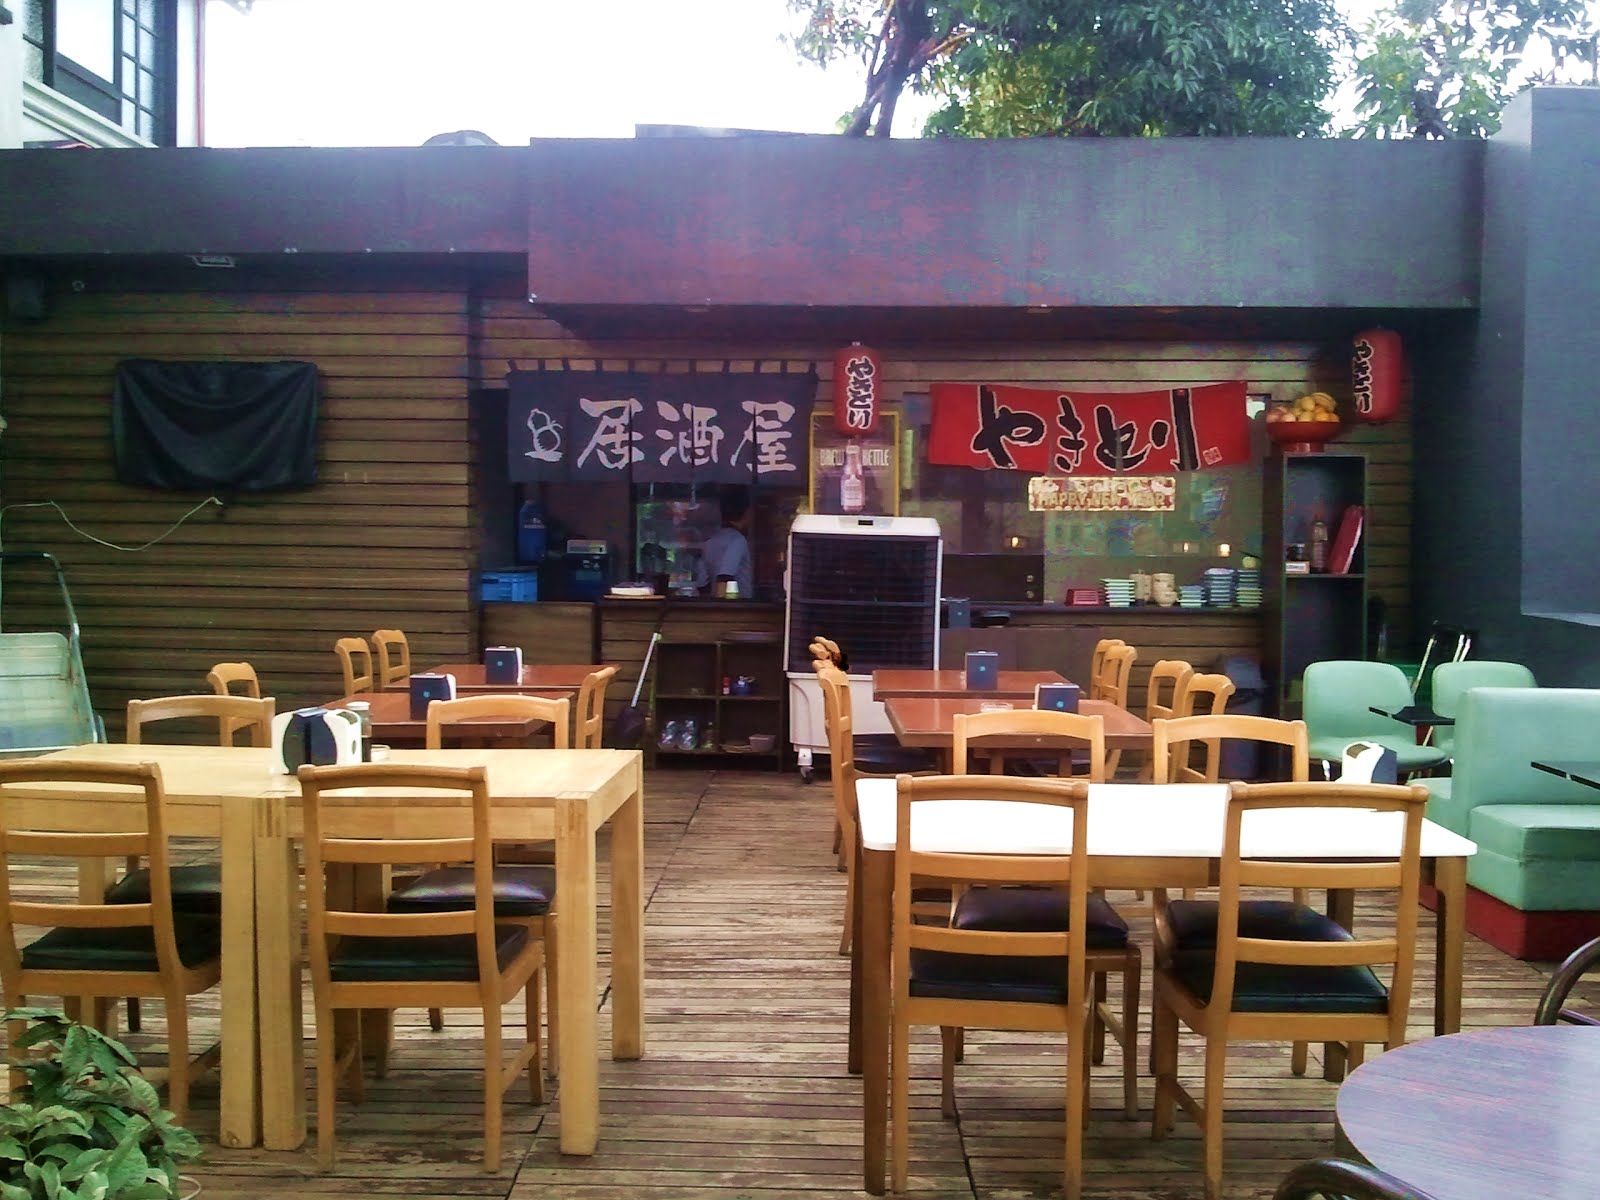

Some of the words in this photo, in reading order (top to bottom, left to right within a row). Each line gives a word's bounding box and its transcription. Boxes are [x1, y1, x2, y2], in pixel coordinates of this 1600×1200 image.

[845, 356, 876, 430] やきとり
[969, 384, 1202, 473] やきとり
[577, 397, 797, 474] 居酒屋
